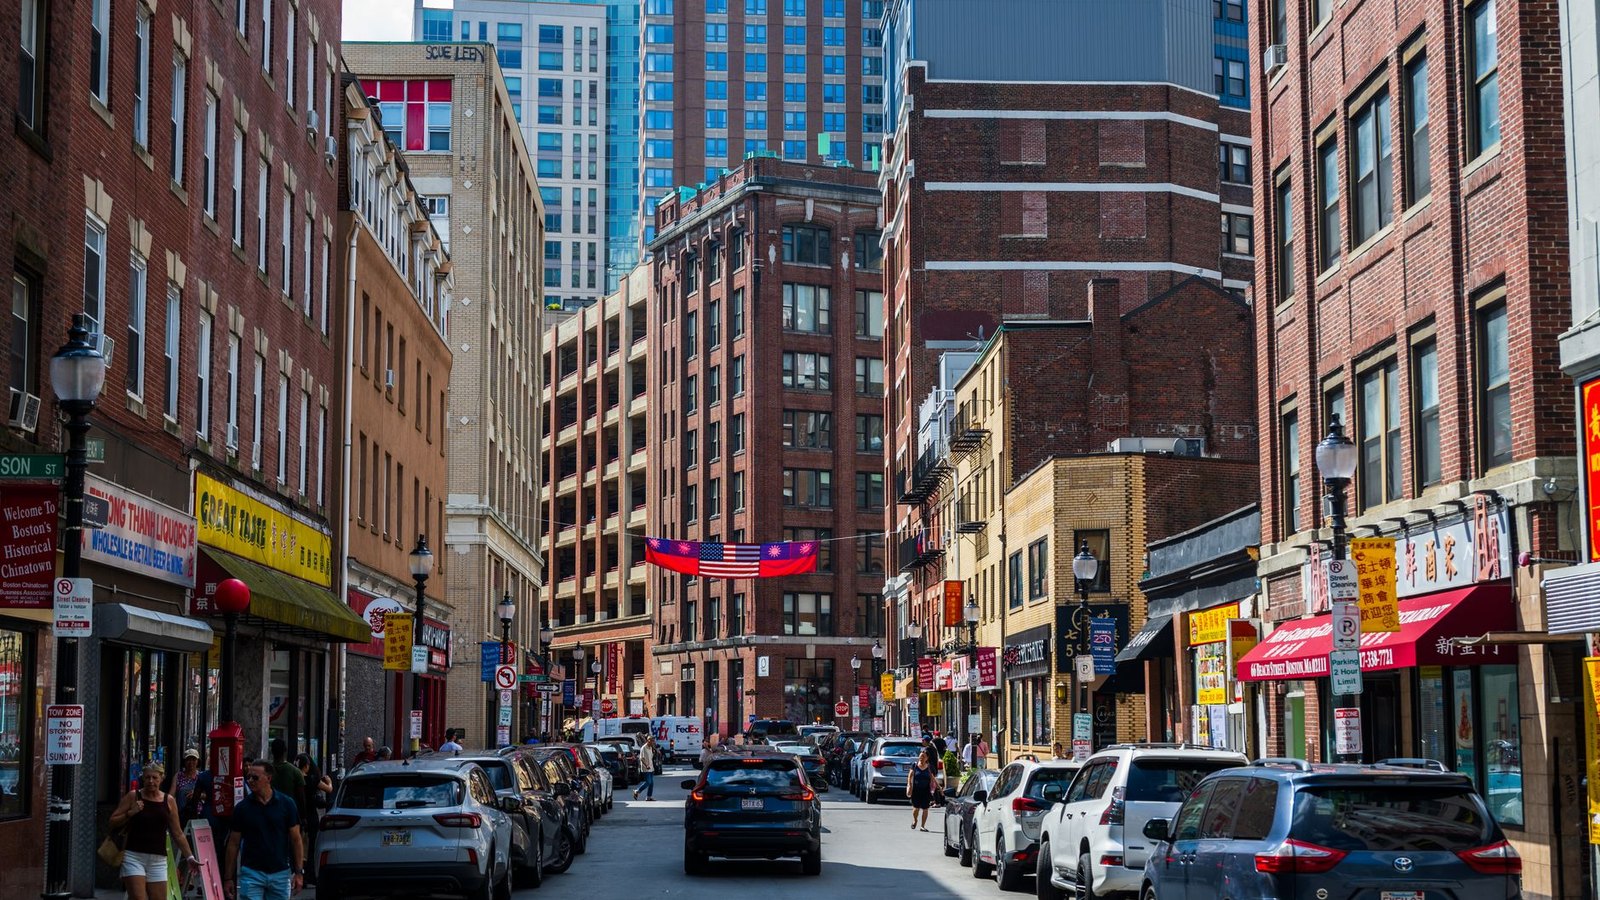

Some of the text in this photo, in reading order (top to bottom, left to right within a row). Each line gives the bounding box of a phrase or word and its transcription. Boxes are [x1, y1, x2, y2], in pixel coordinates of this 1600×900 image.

[45, 464, 56, 475] ST
[4, 500, 56, 521] Welcome To
[128, 503, 156, 538] THANH
[157, 514, 187, 549] LIQUORS
[201, 491, 237, 537] GREAT
[239, 509, 266, 549] TASTE
[12, 522, 52, 539] Boston's
[4, 538, 52, 559] Historical
[91, 528, 127, 559] WHOLESALE
[128, 541, 133, 561] &
[134, 543, 152, 567] RETAIL
[153, 549, 166, 571] BEER
[170, 553, 183, 575] WINE
[1, 561, 52, 578] Chinatown
[1358, 557, 1392, 575] 波士頓
[1331, 582, 1358, 590] Cleaning
[1361, 575, 1388, 589] 華埠
[1362, 590, 1388, 604] 商會
[1093, 634, 1112, 644] 250
[1332, 659, 1359, 667] Parking
[1359, 649, 1393, 668] 17-338-7721
[676, 725, 699, 733] FedEx
[50, 753, 78, 761] SUNDAY
